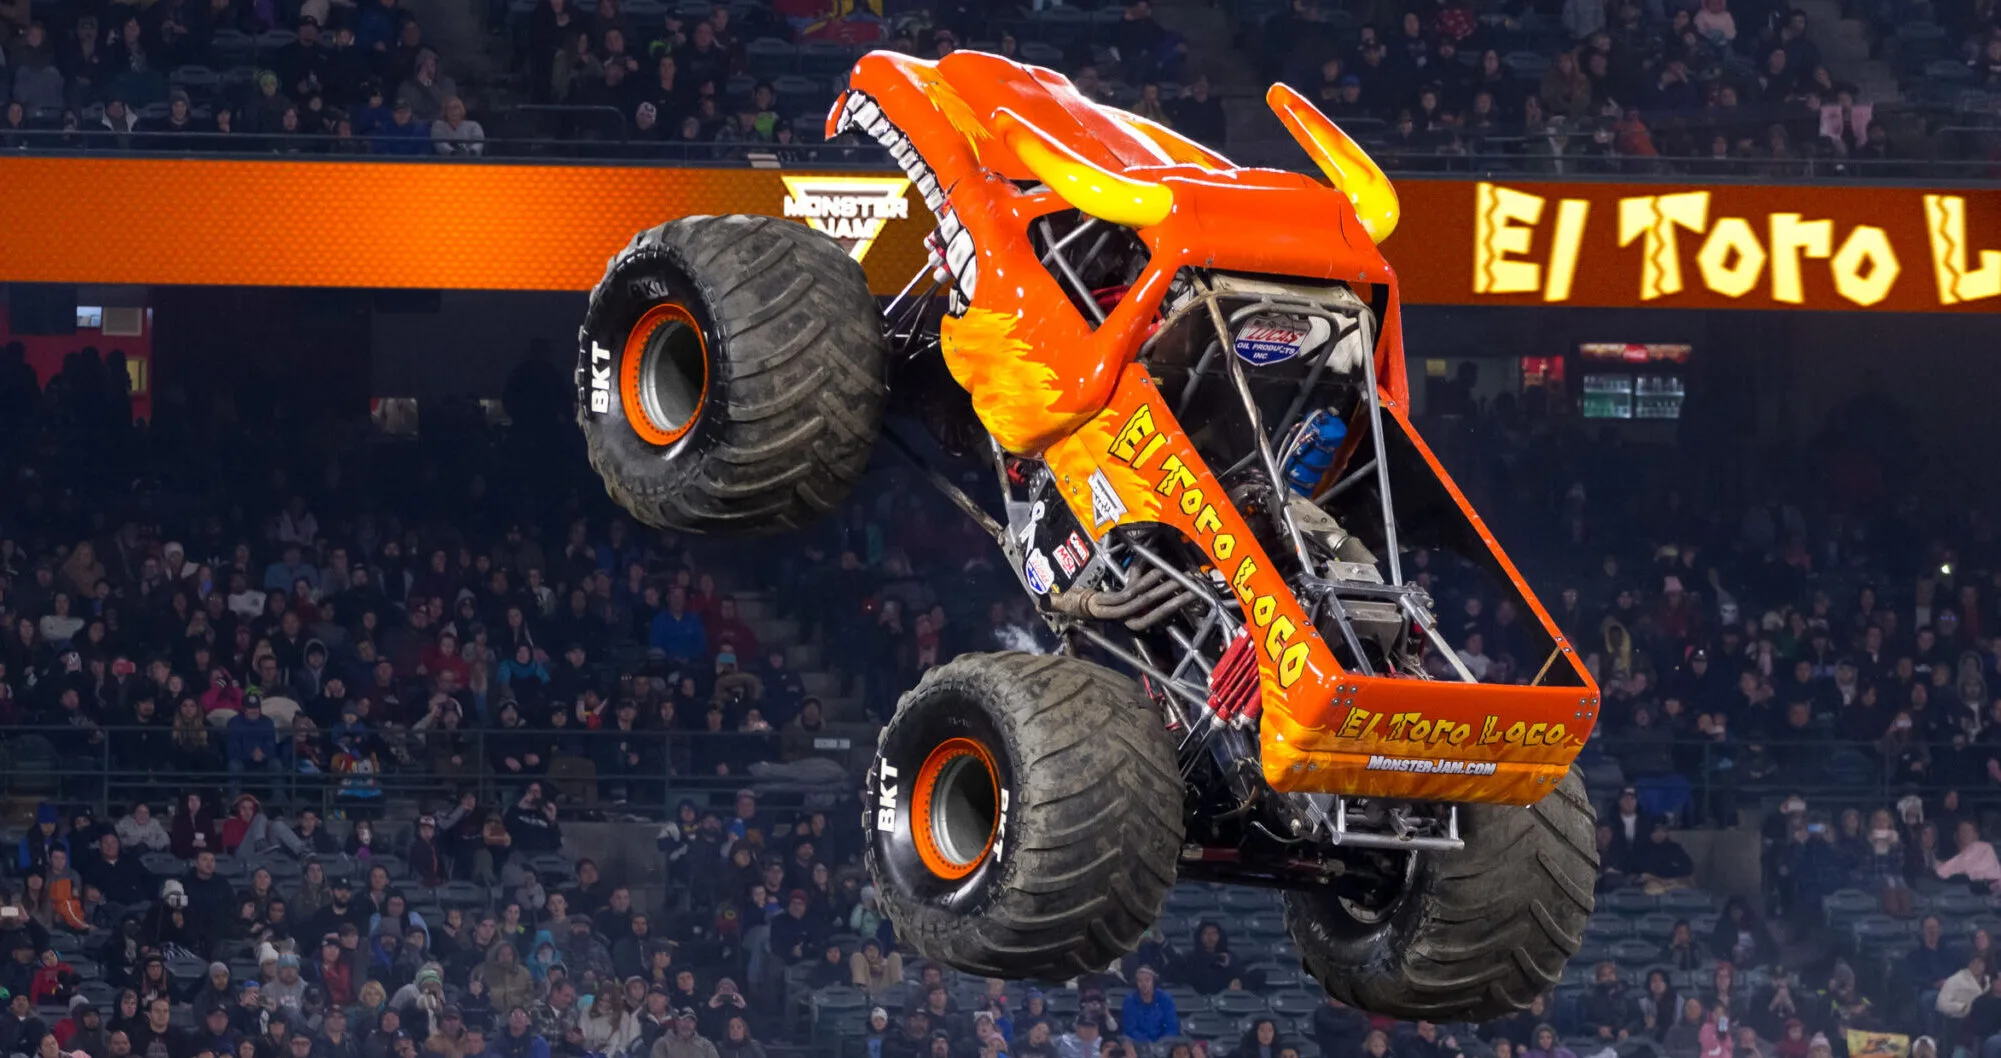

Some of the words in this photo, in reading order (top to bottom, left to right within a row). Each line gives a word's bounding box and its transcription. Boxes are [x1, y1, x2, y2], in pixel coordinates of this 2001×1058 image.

[783, 195, 909, 219] MONSTER
[816, 217, 878, 239] JAM
[1474, 181, 1590, 302] El
[1617, 191, 1901, 306] Toro
[1245, 327, 1303, 343] LUCAS
[1236, 342, 1250, 350] OIL
[1251, 343, 1296, 355] PRODUCTS
[591, 341, 611, 414] BKT
[877, 758, 898, 832] BKT
